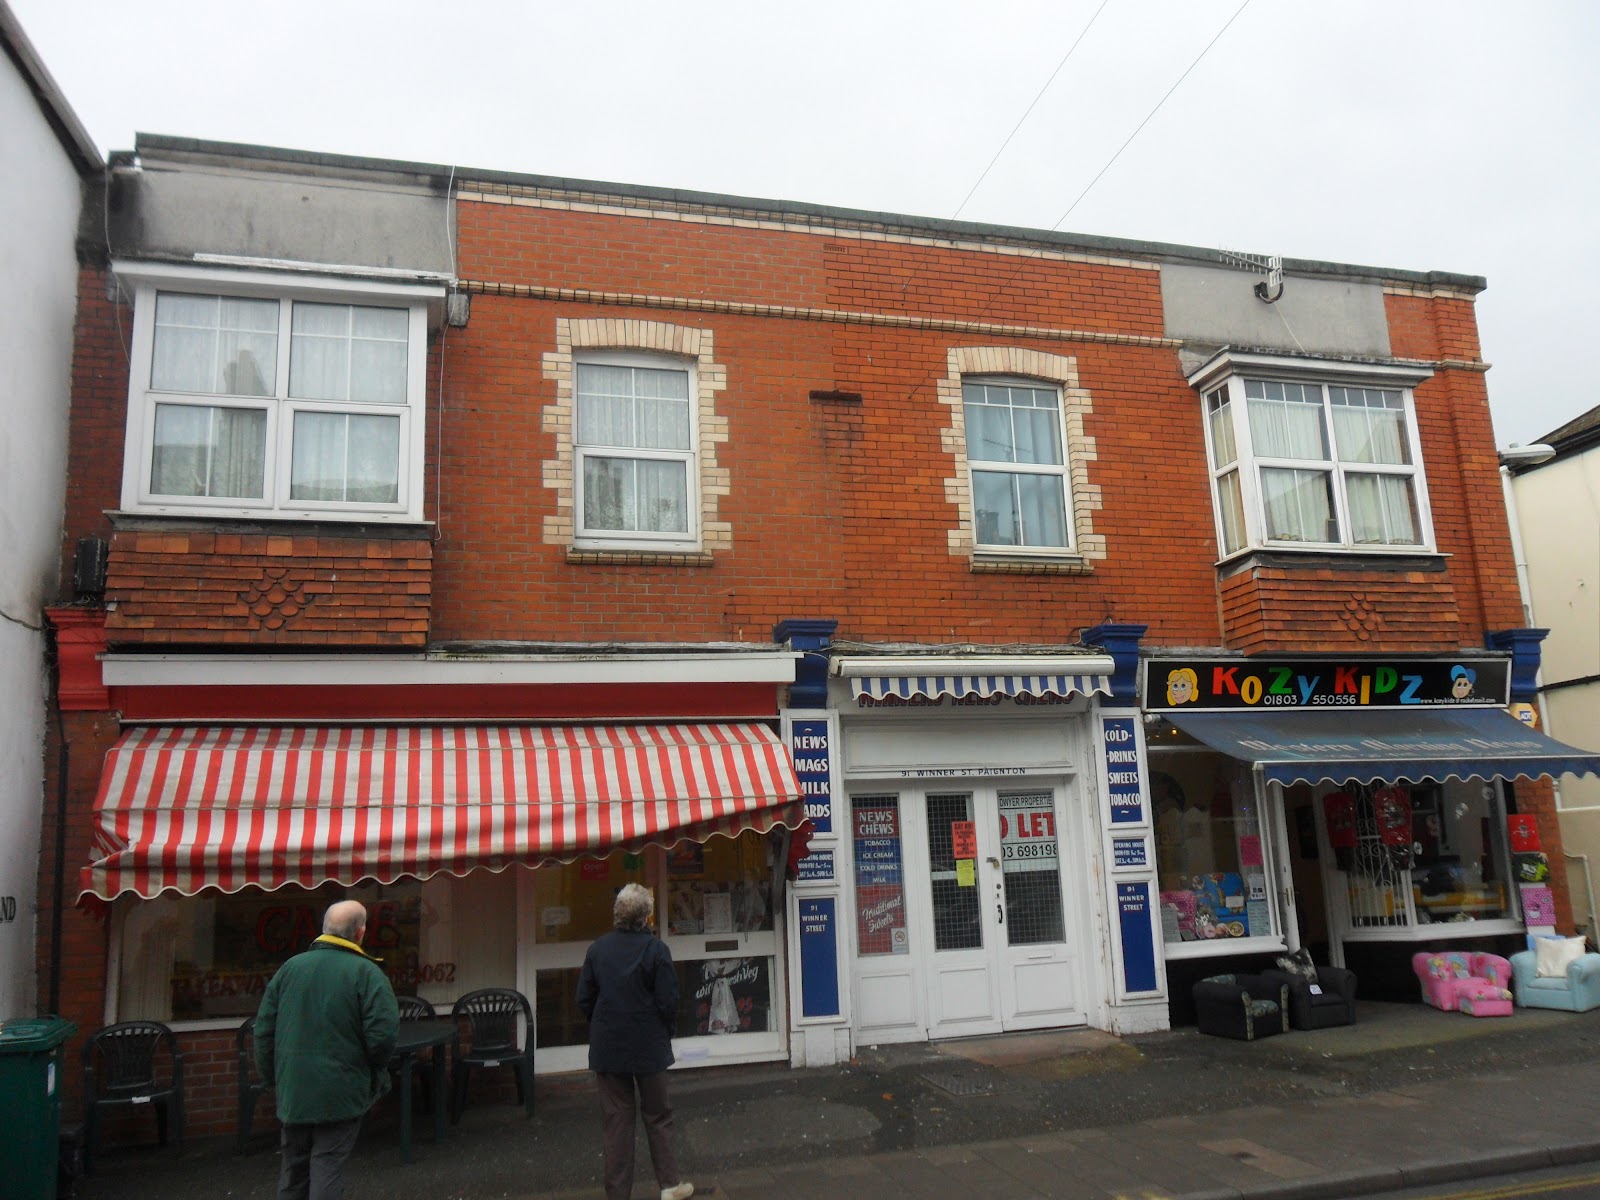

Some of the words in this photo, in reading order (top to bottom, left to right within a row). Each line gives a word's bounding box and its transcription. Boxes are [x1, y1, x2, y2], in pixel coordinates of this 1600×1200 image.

[1263, 694, 1298, 705] 01803
[1312, 694, 1357, 705] 550556
[794, 736, 828, 750] NEWS
[795, 758, 829, 772] MAGS
[916, 769, 955, 777] WINNER
[978, 767, 1025, 775] PAIGNTON
[1108, 772, 1139, 785] SWEETS
[1110, 793, 1141, 806] TOBACCO
[803, 804, 831, 818] ARDS
[859, 811, 893, 823] NEWS
[859, 824, 895, 836] CHEWS
[802, 914, 828, 922] WINNER
[805, 924, 825, 932] STREET
